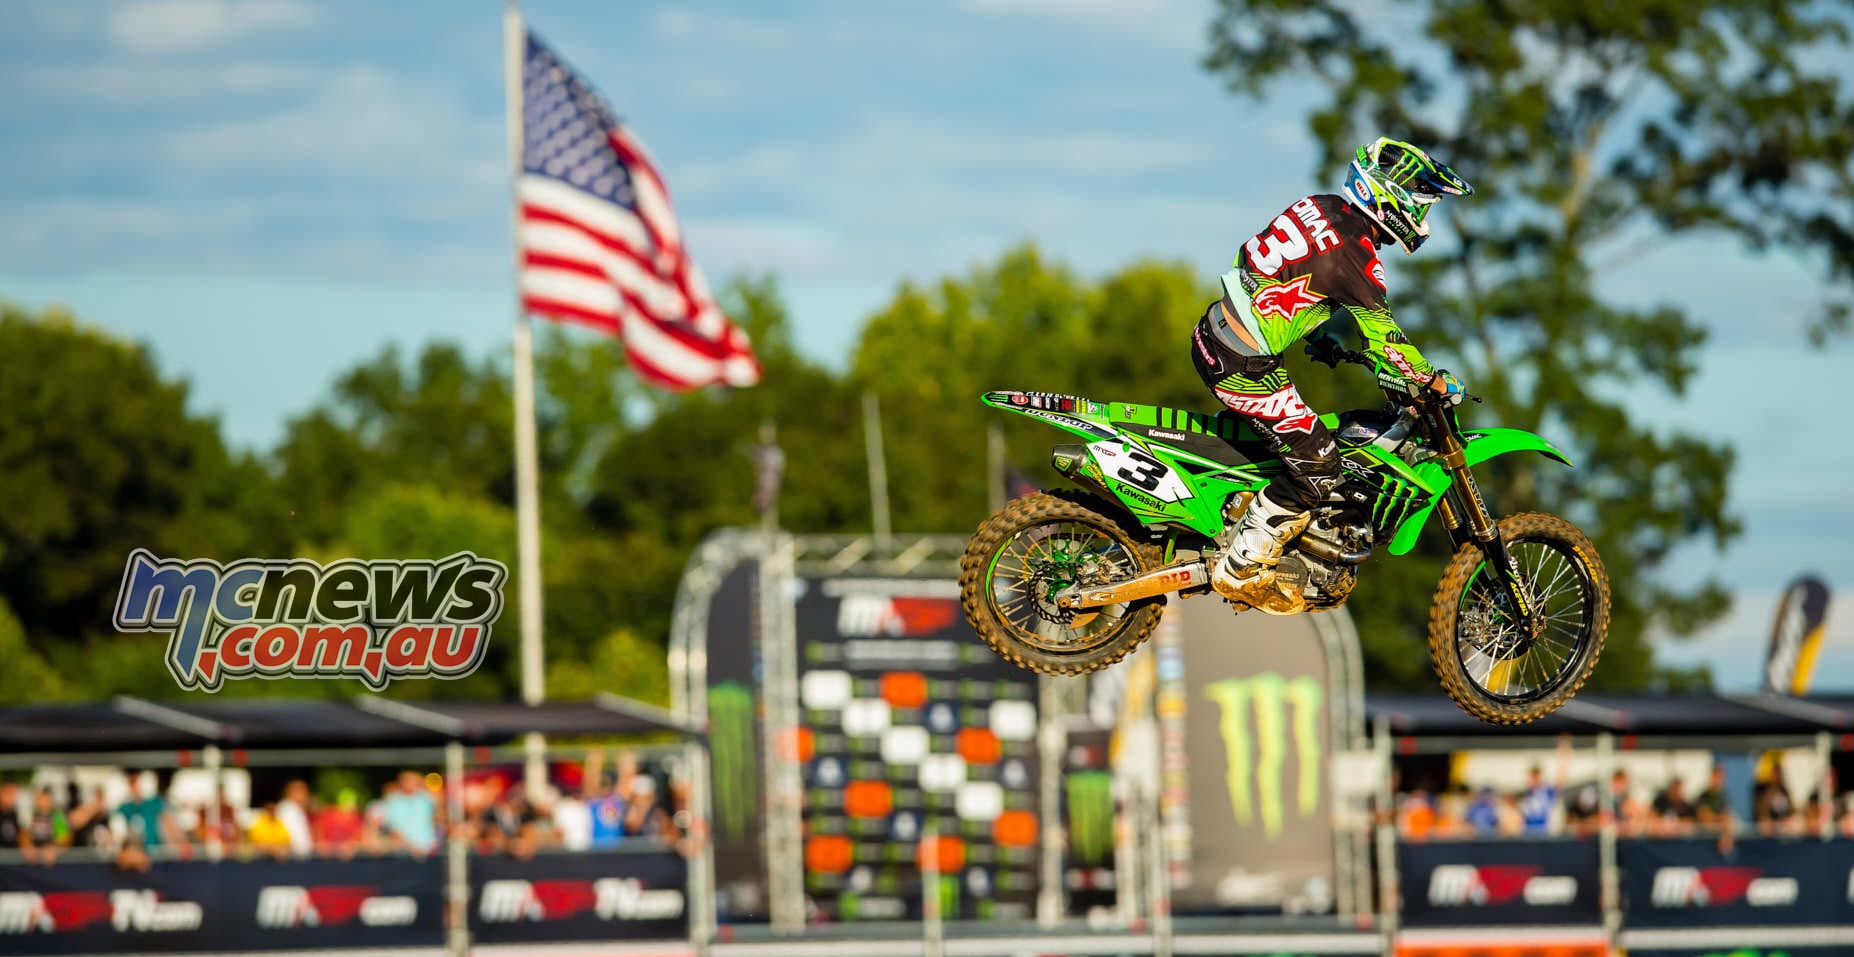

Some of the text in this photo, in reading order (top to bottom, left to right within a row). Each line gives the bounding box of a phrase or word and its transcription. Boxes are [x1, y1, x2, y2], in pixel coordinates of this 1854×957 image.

[1356, 181, 1368, 198] BELL
[1246, 214, 1309, 276] 3
[1148, 429, 1185, 441] Kawasaki
[1117, 451, 1169, 492] 3
[1115, 483, 1167, 512] Kawasaki
